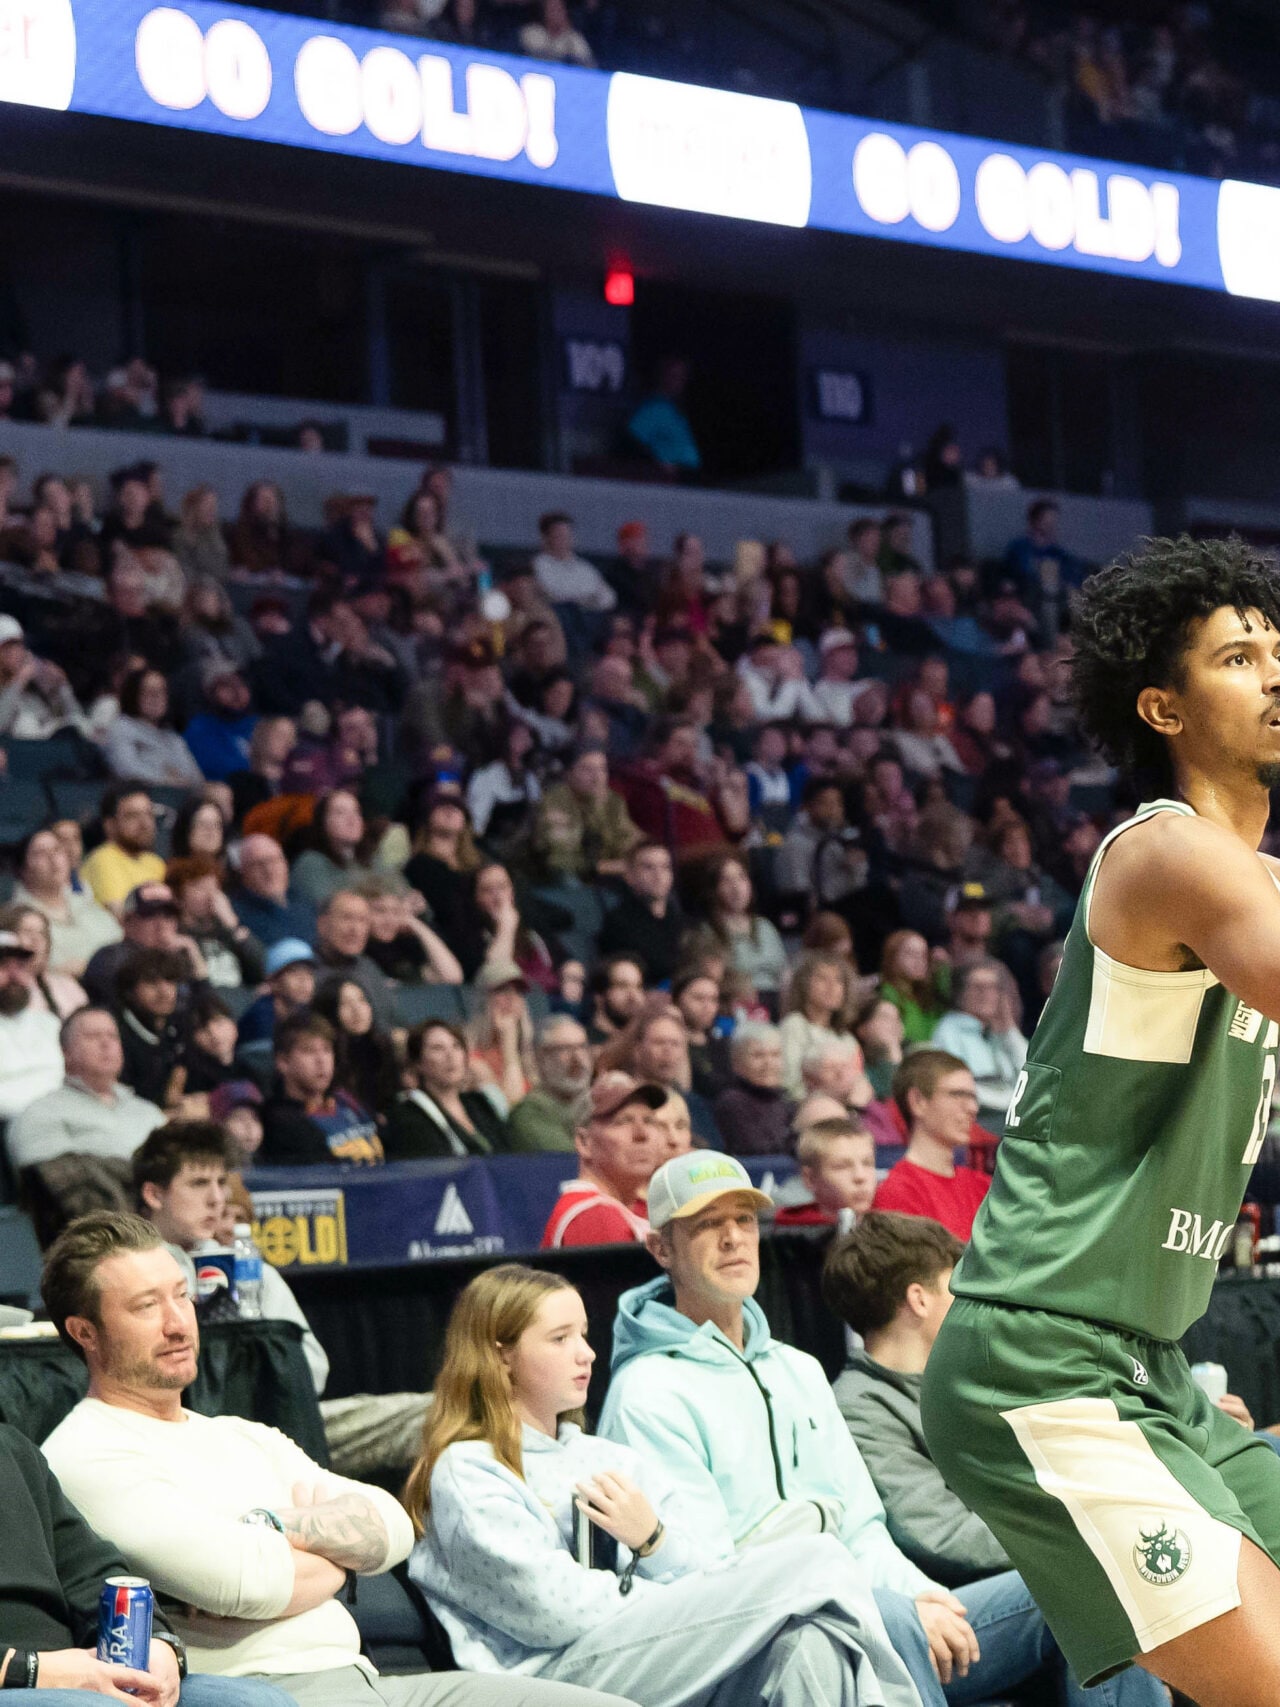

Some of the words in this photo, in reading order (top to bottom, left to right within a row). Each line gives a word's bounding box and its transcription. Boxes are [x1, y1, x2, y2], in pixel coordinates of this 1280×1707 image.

[135, 7, 272, 120] GO
[294, 35, 559, 169] GOLD!
[852, 132, 960, 232] GO
[975, 153, 1182, 268] GOLD!
